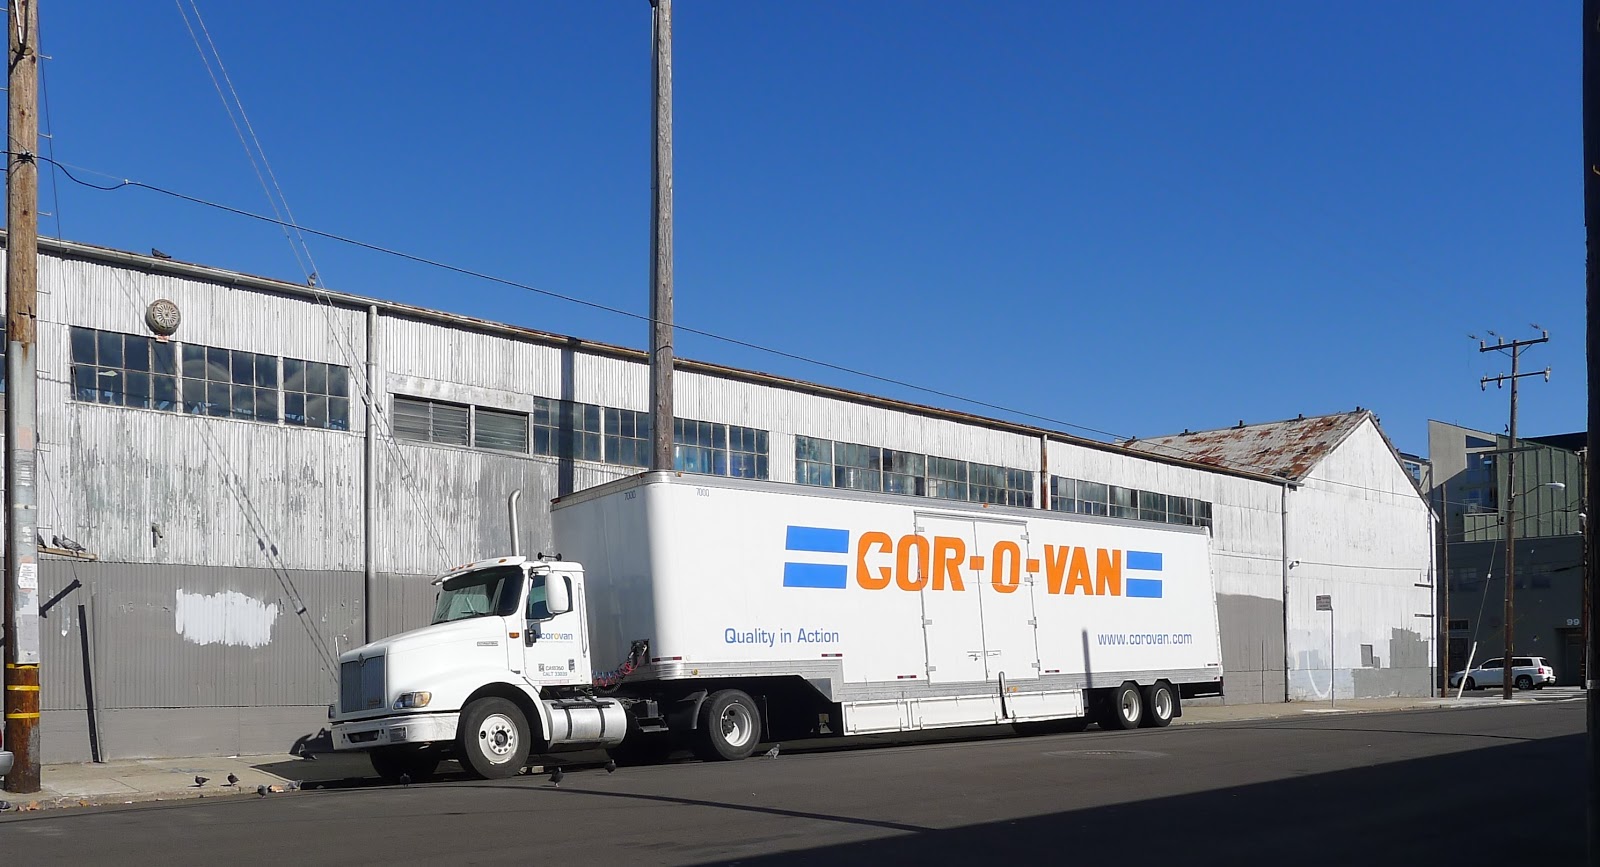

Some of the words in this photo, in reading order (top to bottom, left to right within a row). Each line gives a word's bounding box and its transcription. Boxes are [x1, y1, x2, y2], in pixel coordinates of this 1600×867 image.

[624, 490, 636, 500] 7000
[696, 487, 709, 497] 7000
[856, 531, 1122, 597] COR-O-VAN
[1566, 618, 1580, 626] 99
[540, 632, 573, 640] corovan
[724, 627, 775, 648] Quality
[780, 627, 792, 643] in
[797, 627, 839, 643] Action
[1097, 633, 1193, 646] www.corovan.com
